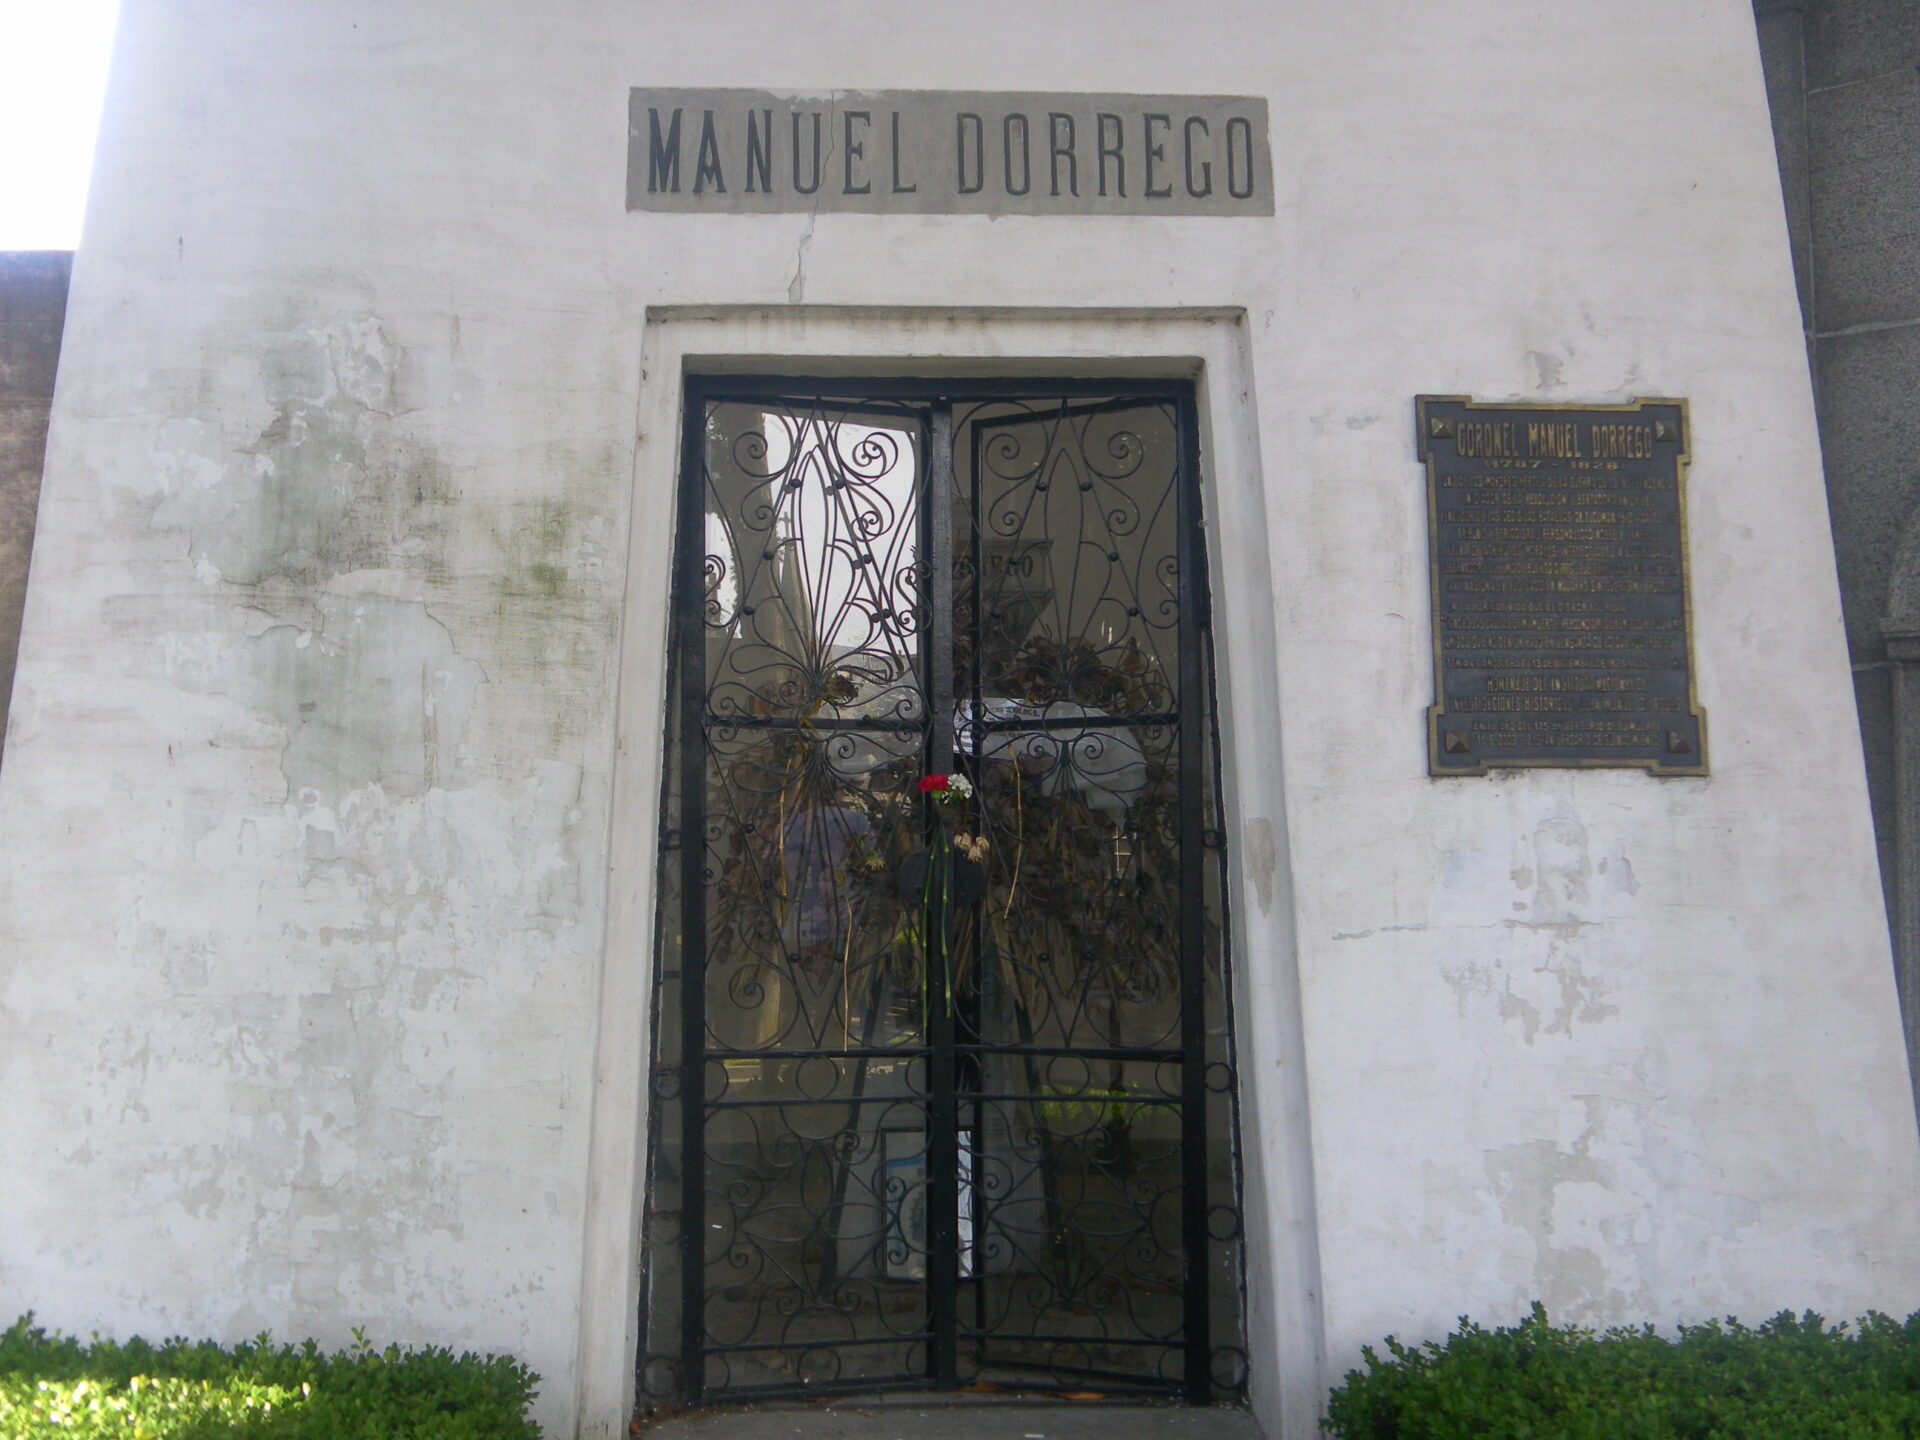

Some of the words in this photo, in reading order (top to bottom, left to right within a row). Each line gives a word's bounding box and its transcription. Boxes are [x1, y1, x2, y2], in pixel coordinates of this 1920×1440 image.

[647, 107, 917, 194] MANUEL
[956, 112, 1254, 199] DORREGO
[1457, 422, 1519, 457] CORONEL
[1528, 423, 1581, 458] MANUEL
[1592, 425, 1652, 458] DORREGO
